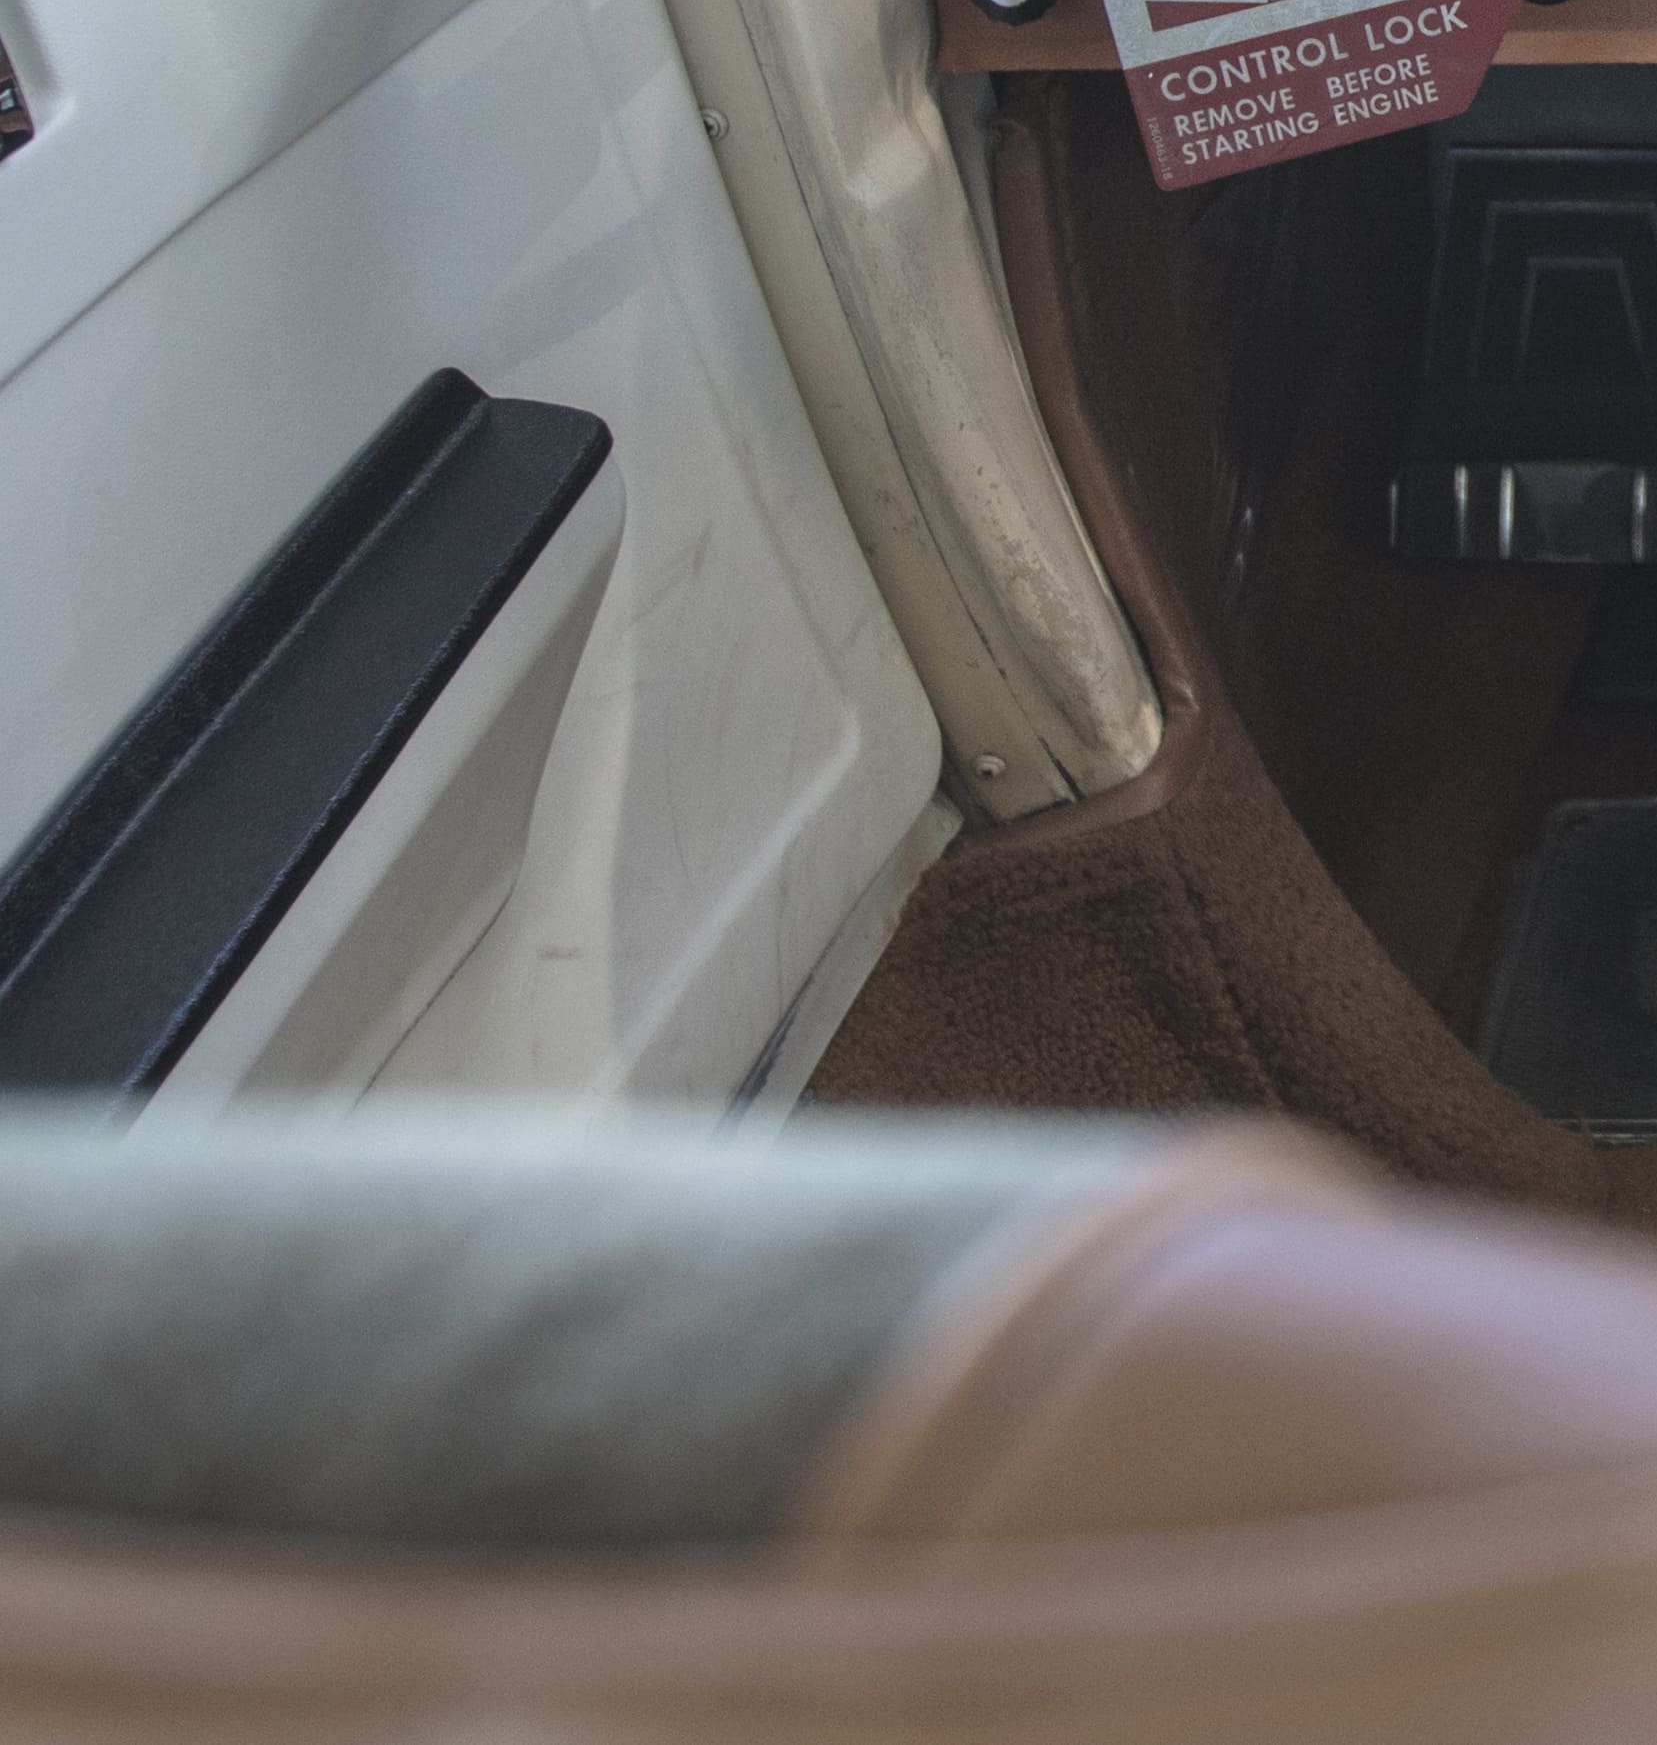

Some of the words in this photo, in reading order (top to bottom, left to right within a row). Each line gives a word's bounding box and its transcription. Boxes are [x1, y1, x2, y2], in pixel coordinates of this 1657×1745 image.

[1160, 33, 1350, 103] CONTROL
[1366, 1, 1469, 53] LOCK
[1174, 87, 1298, 137] REMOVE
[1326, 54, 1433, 99] BEFORE
[1181, 111, 1319, 166] STARTING
[1334, 81, 1441, 127] ENGINE
